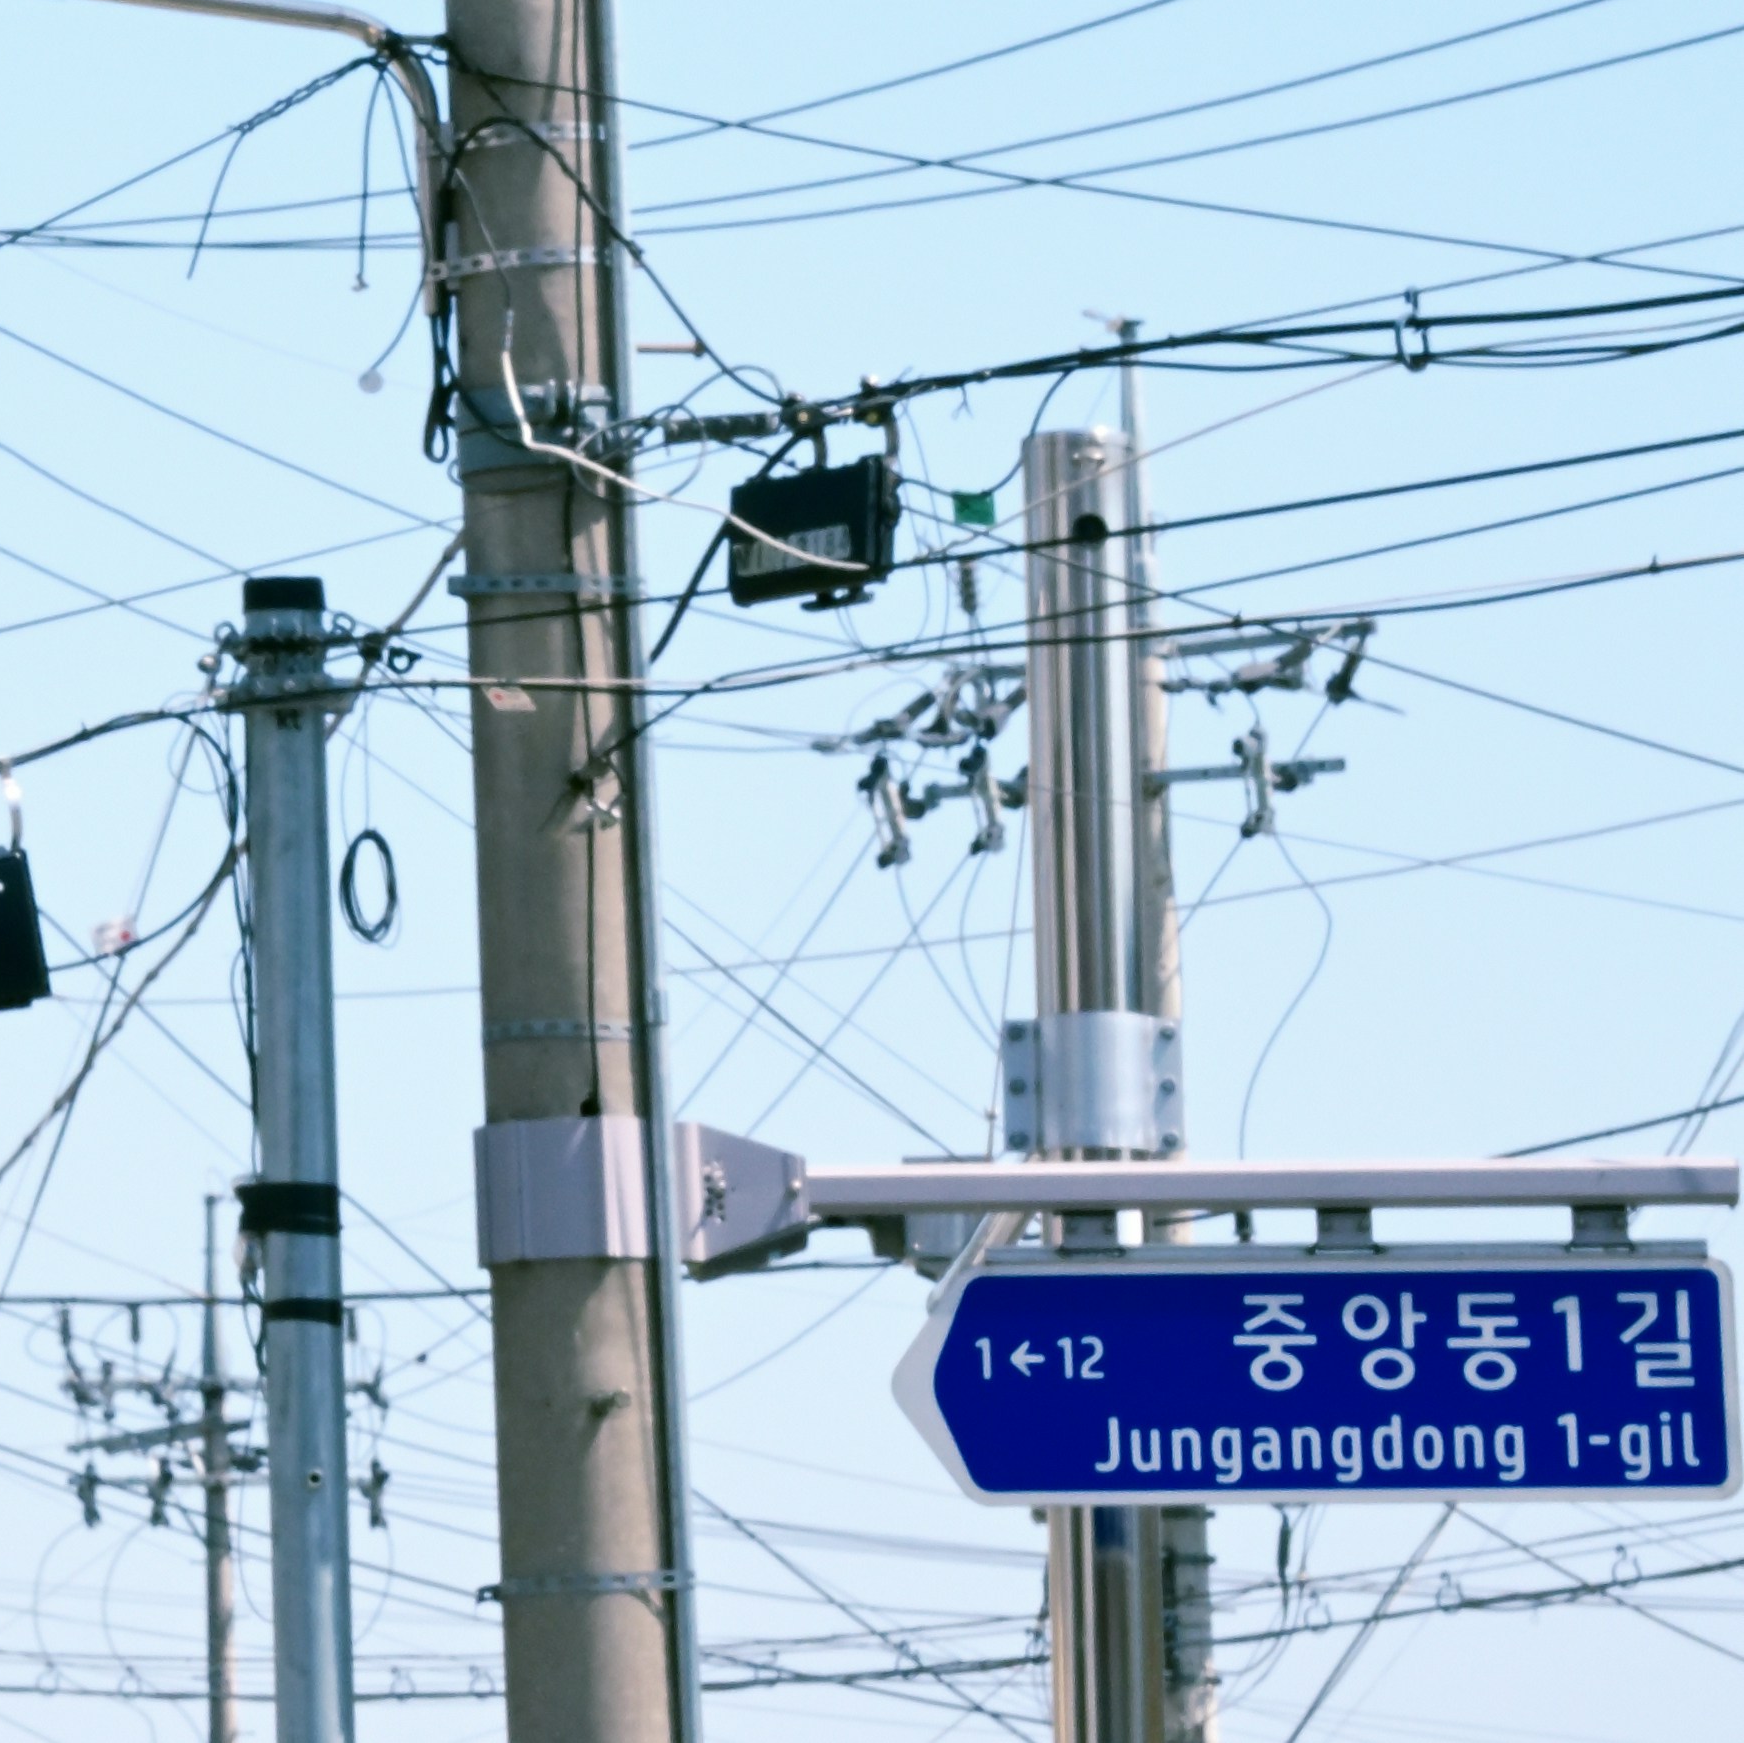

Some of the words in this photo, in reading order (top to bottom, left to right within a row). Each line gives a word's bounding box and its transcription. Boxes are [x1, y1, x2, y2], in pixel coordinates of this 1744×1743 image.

[1232, 1289, 1697, 1393] 중앙동1길
[1095, 1414, 1527, 1484] Jungangdong
[1555, 1411, 1702, 1482] 1-gil
